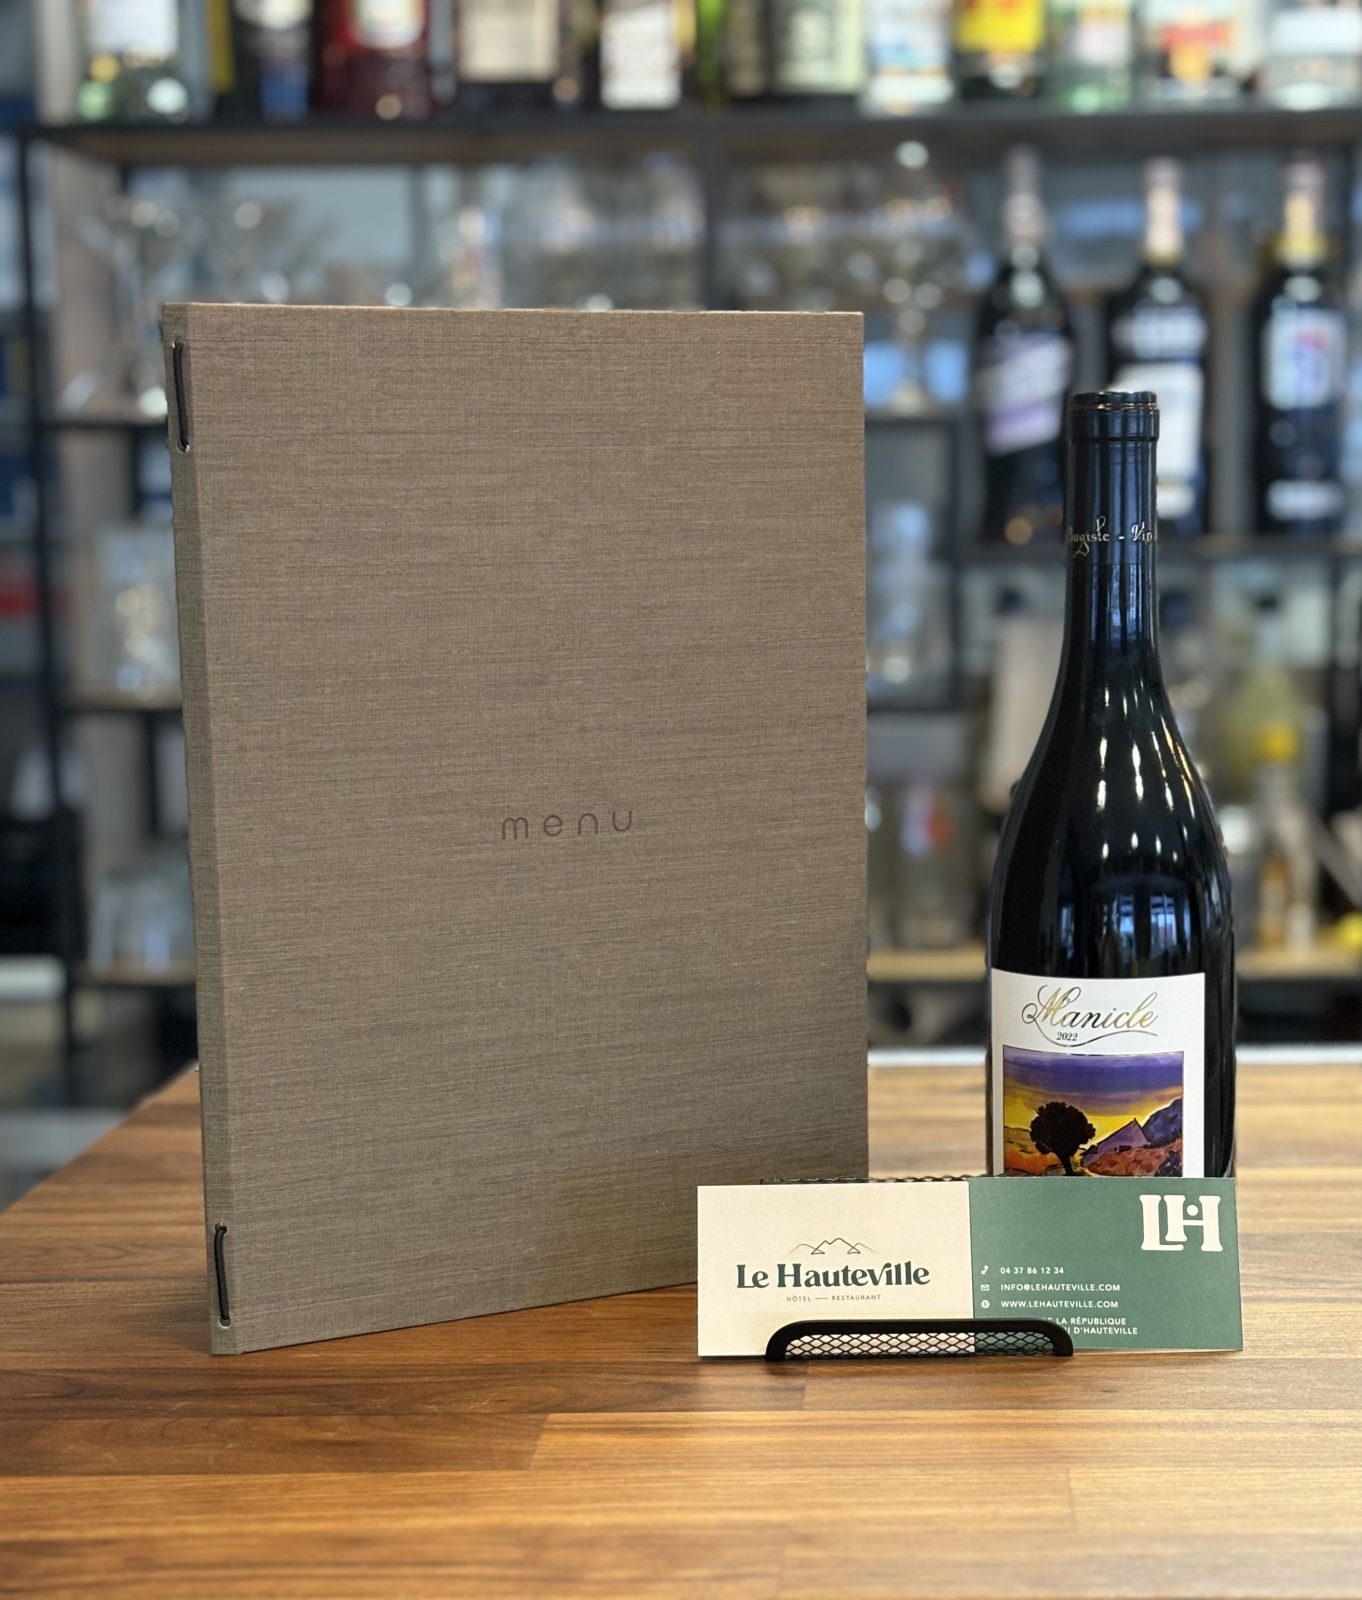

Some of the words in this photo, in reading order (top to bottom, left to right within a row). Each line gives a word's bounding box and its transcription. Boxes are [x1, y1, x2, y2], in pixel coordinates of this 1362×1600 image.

[501, 810, 632, 840] menu
[1021, 984, 1159, 1029] Manicle
[1056, 1031, 1079, 1041] 2022
[1139, 1194, 1223, 1251] LH
[736, 1264, 770, 1289] Le
[776, 1260, 931, 1288] Hauteville
[1000, 1266, 1011, 1274] 04
[1013, 1266, 1024, 1274] 37
[1026, 1266, 1037, 1274] 86
[1041, 1266, 1051, 1274] 12
[1053, 1266, 1064, 1274] 34
[1000, 1283, 1120, 1291] INFO@LEHAUTEVILLE.COM
[1001, 1300, 1119, 1308] WWW.LEHAUTEVILLE.COM
[1056, 1317, 1068, 1325] LA
[1070, 1315, 1127, 1325] RÉPUBLIQUE
[1073, 1327, 1139, 1335] D'HAUTEVILLE
